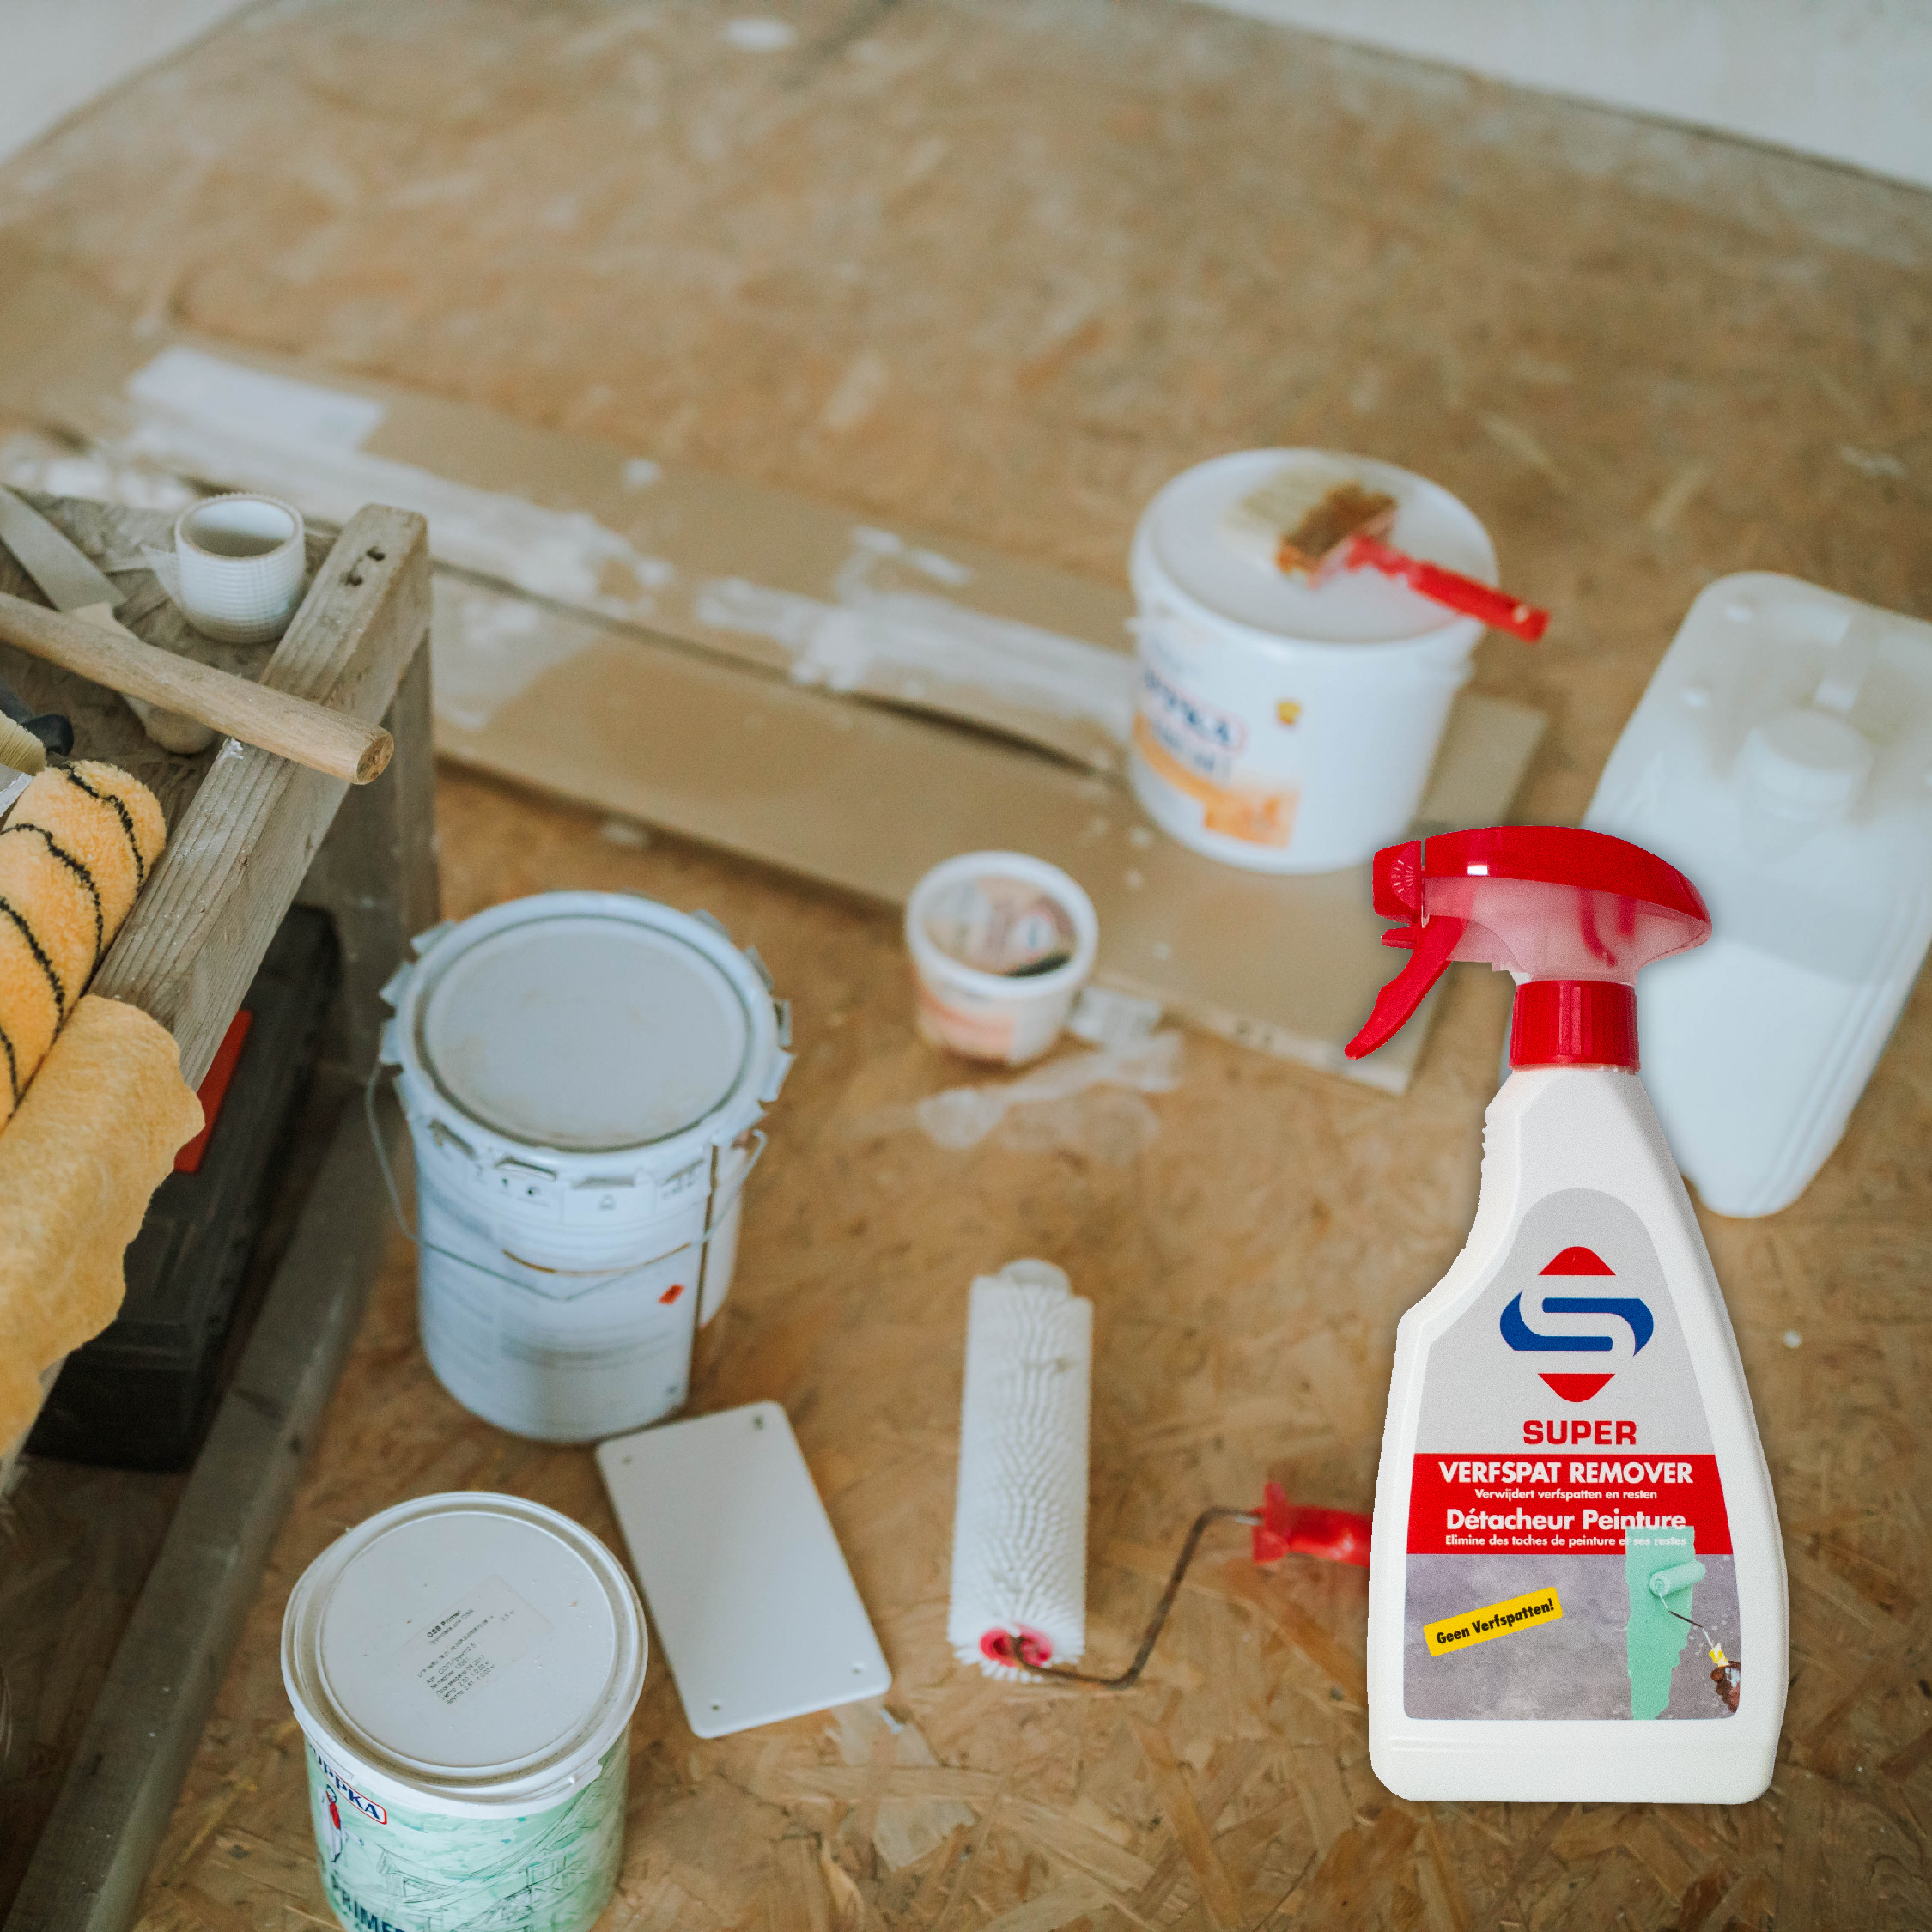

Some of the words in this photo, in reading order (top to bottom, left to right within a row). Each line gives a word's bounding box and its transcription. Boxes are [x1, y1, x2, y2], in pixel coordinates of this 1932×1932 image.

[1523, 1420, 1637, 1445] SUPER
[1438, 1461, 1561, 1484] VERFSPAT
[1569, 1461, 1693, 1484] REMOVER
[1474, 1488, 1534, 1501] Verwijdert
[1538, 1488, 1602, 1501] verfspatten
[1623, 1489, 1657, 1499] resten
[1447, 1507, 1575, 1530] Détacheur
[1583, 1508, 1686, 1530] Peinture
[1445, 1534, 1485, 1546] Elimine
[1488, 1534, 1509, 1546] des
[1511, 1534, 1548, 1546] taches
[1551, 1534, 1565, 1546] de
[1568, 1534, 1616, 1548] peinture
[1619, 1536, 1630, 1546] et
[1633, 1537, 1650, 1546] ses
[1654, 1536, 1686, 1546] restes
[426, 1625, 442, 1638] OSB
[440, 1609, 462, 1627] Primer
[1437, 1628, 1470, 1644] Geen
[1471, 1598, 1554, 1634] Verfspatten!
